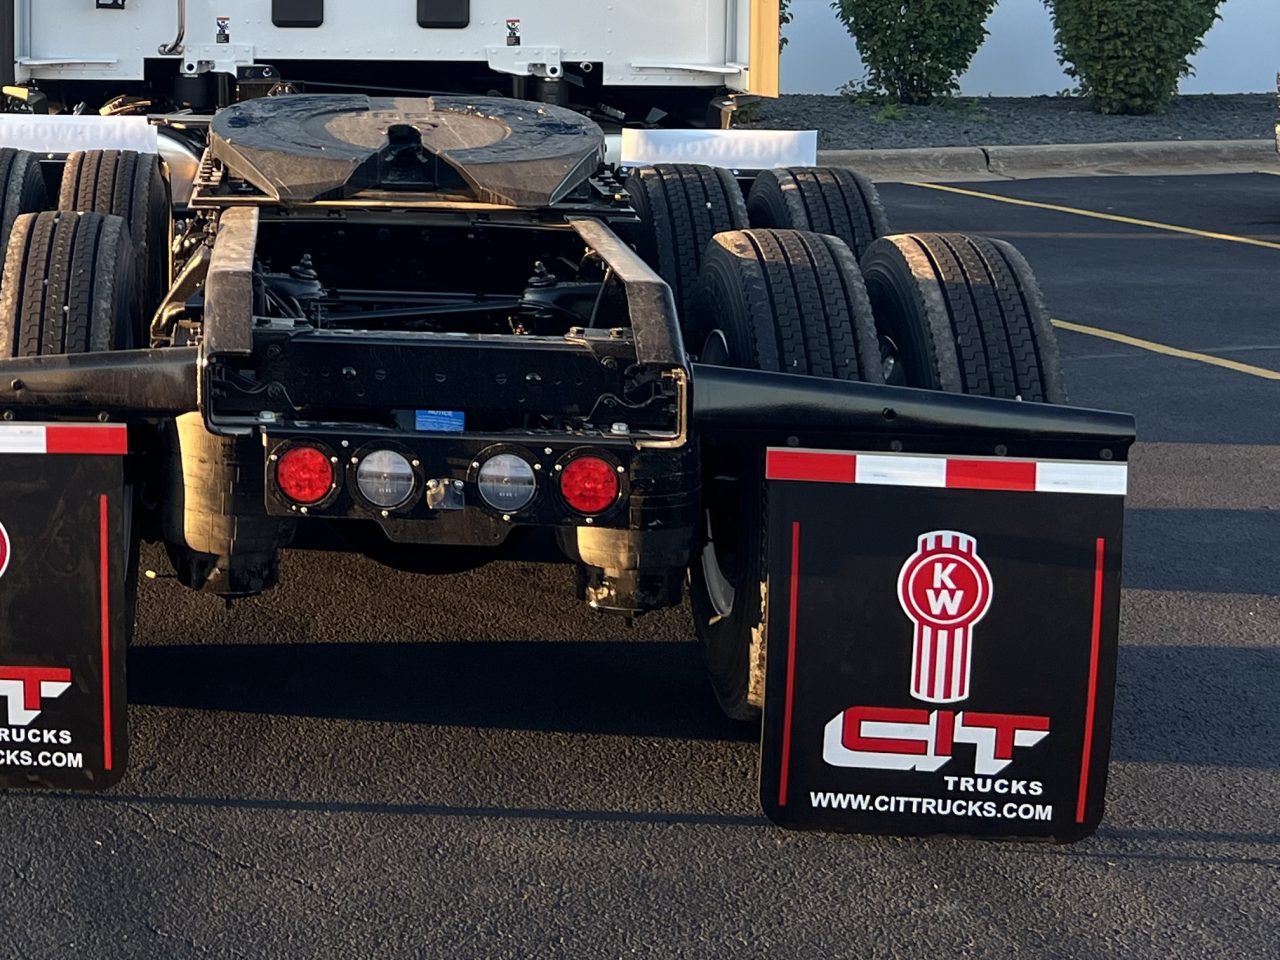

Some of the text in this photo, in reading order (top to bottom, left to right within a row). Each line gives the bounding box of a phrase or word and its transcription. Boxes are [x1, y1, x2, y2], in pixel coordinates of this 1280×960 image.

[822, 706, 1051, 775] CIT
[943, 776, 1043, 795] TRUCKS
[809, 792, 1053, 821] WWW.CITTRUCKS.COM
